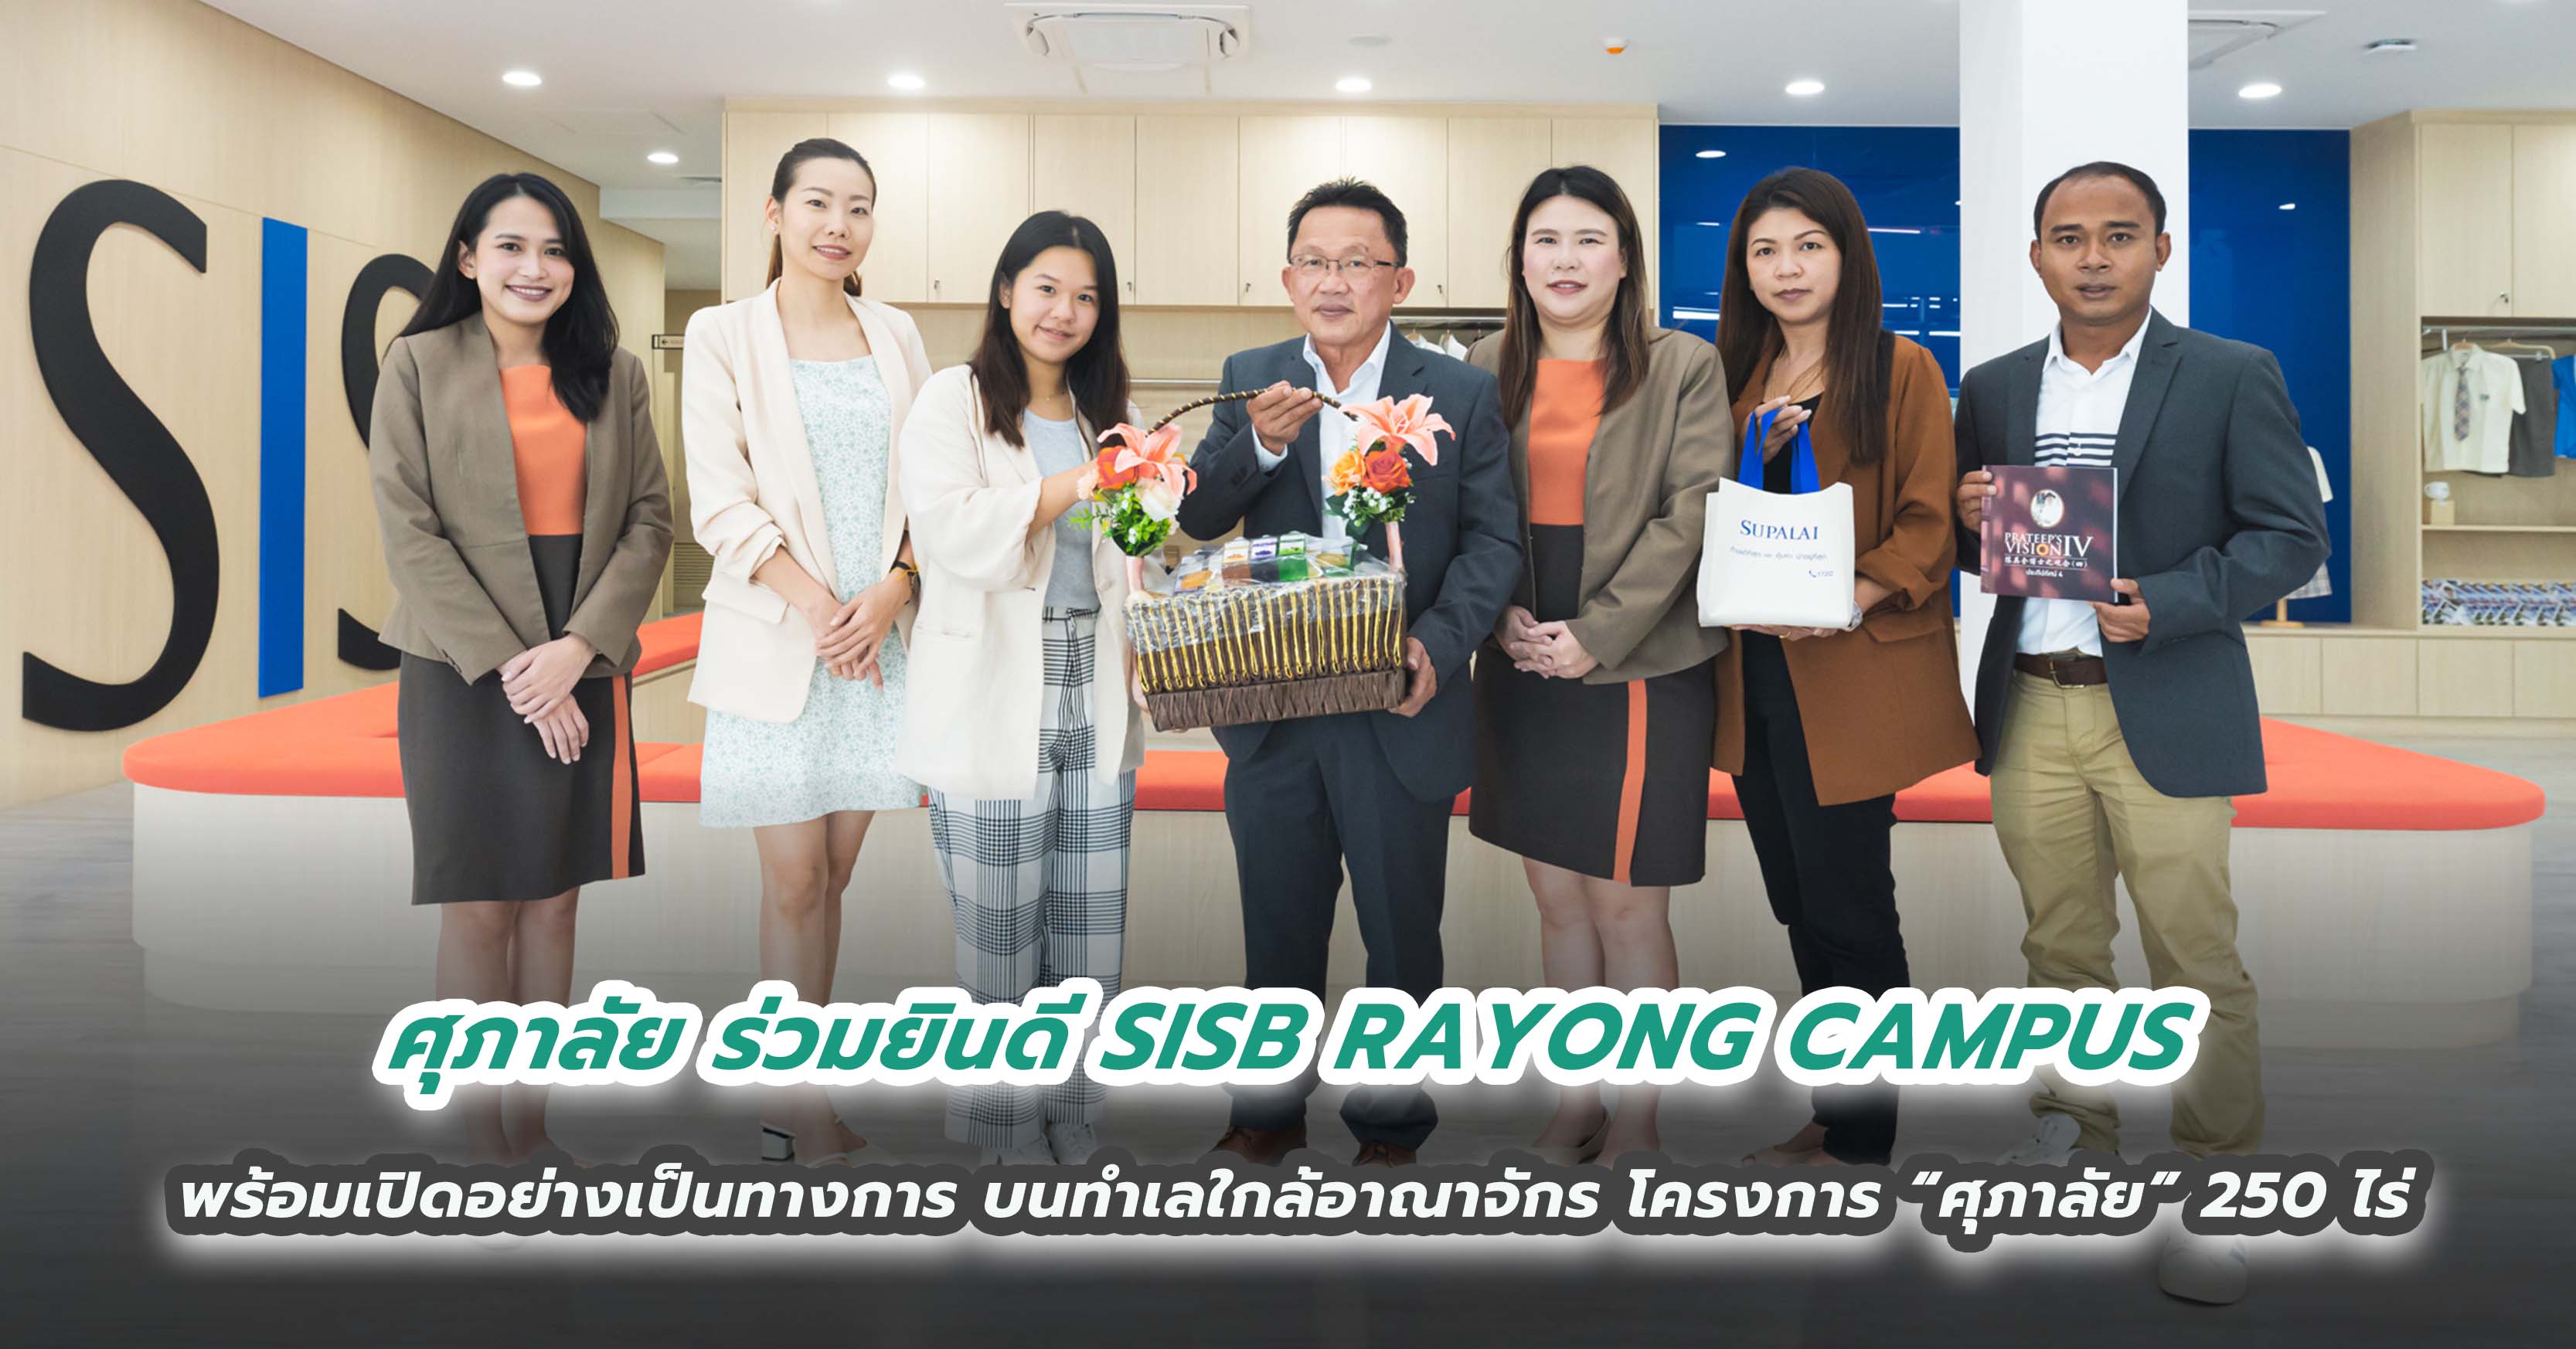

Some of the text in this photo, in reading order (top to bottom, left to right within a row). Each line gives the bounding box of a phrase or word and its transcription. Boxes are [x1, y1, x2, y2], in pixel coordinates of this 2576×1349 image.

[1740, 519, 1819, 540] SUPALAI
[2004, 532, 2062, 544] PRATEEP'S
[2006, 535, 2094, 557] VISION IV
